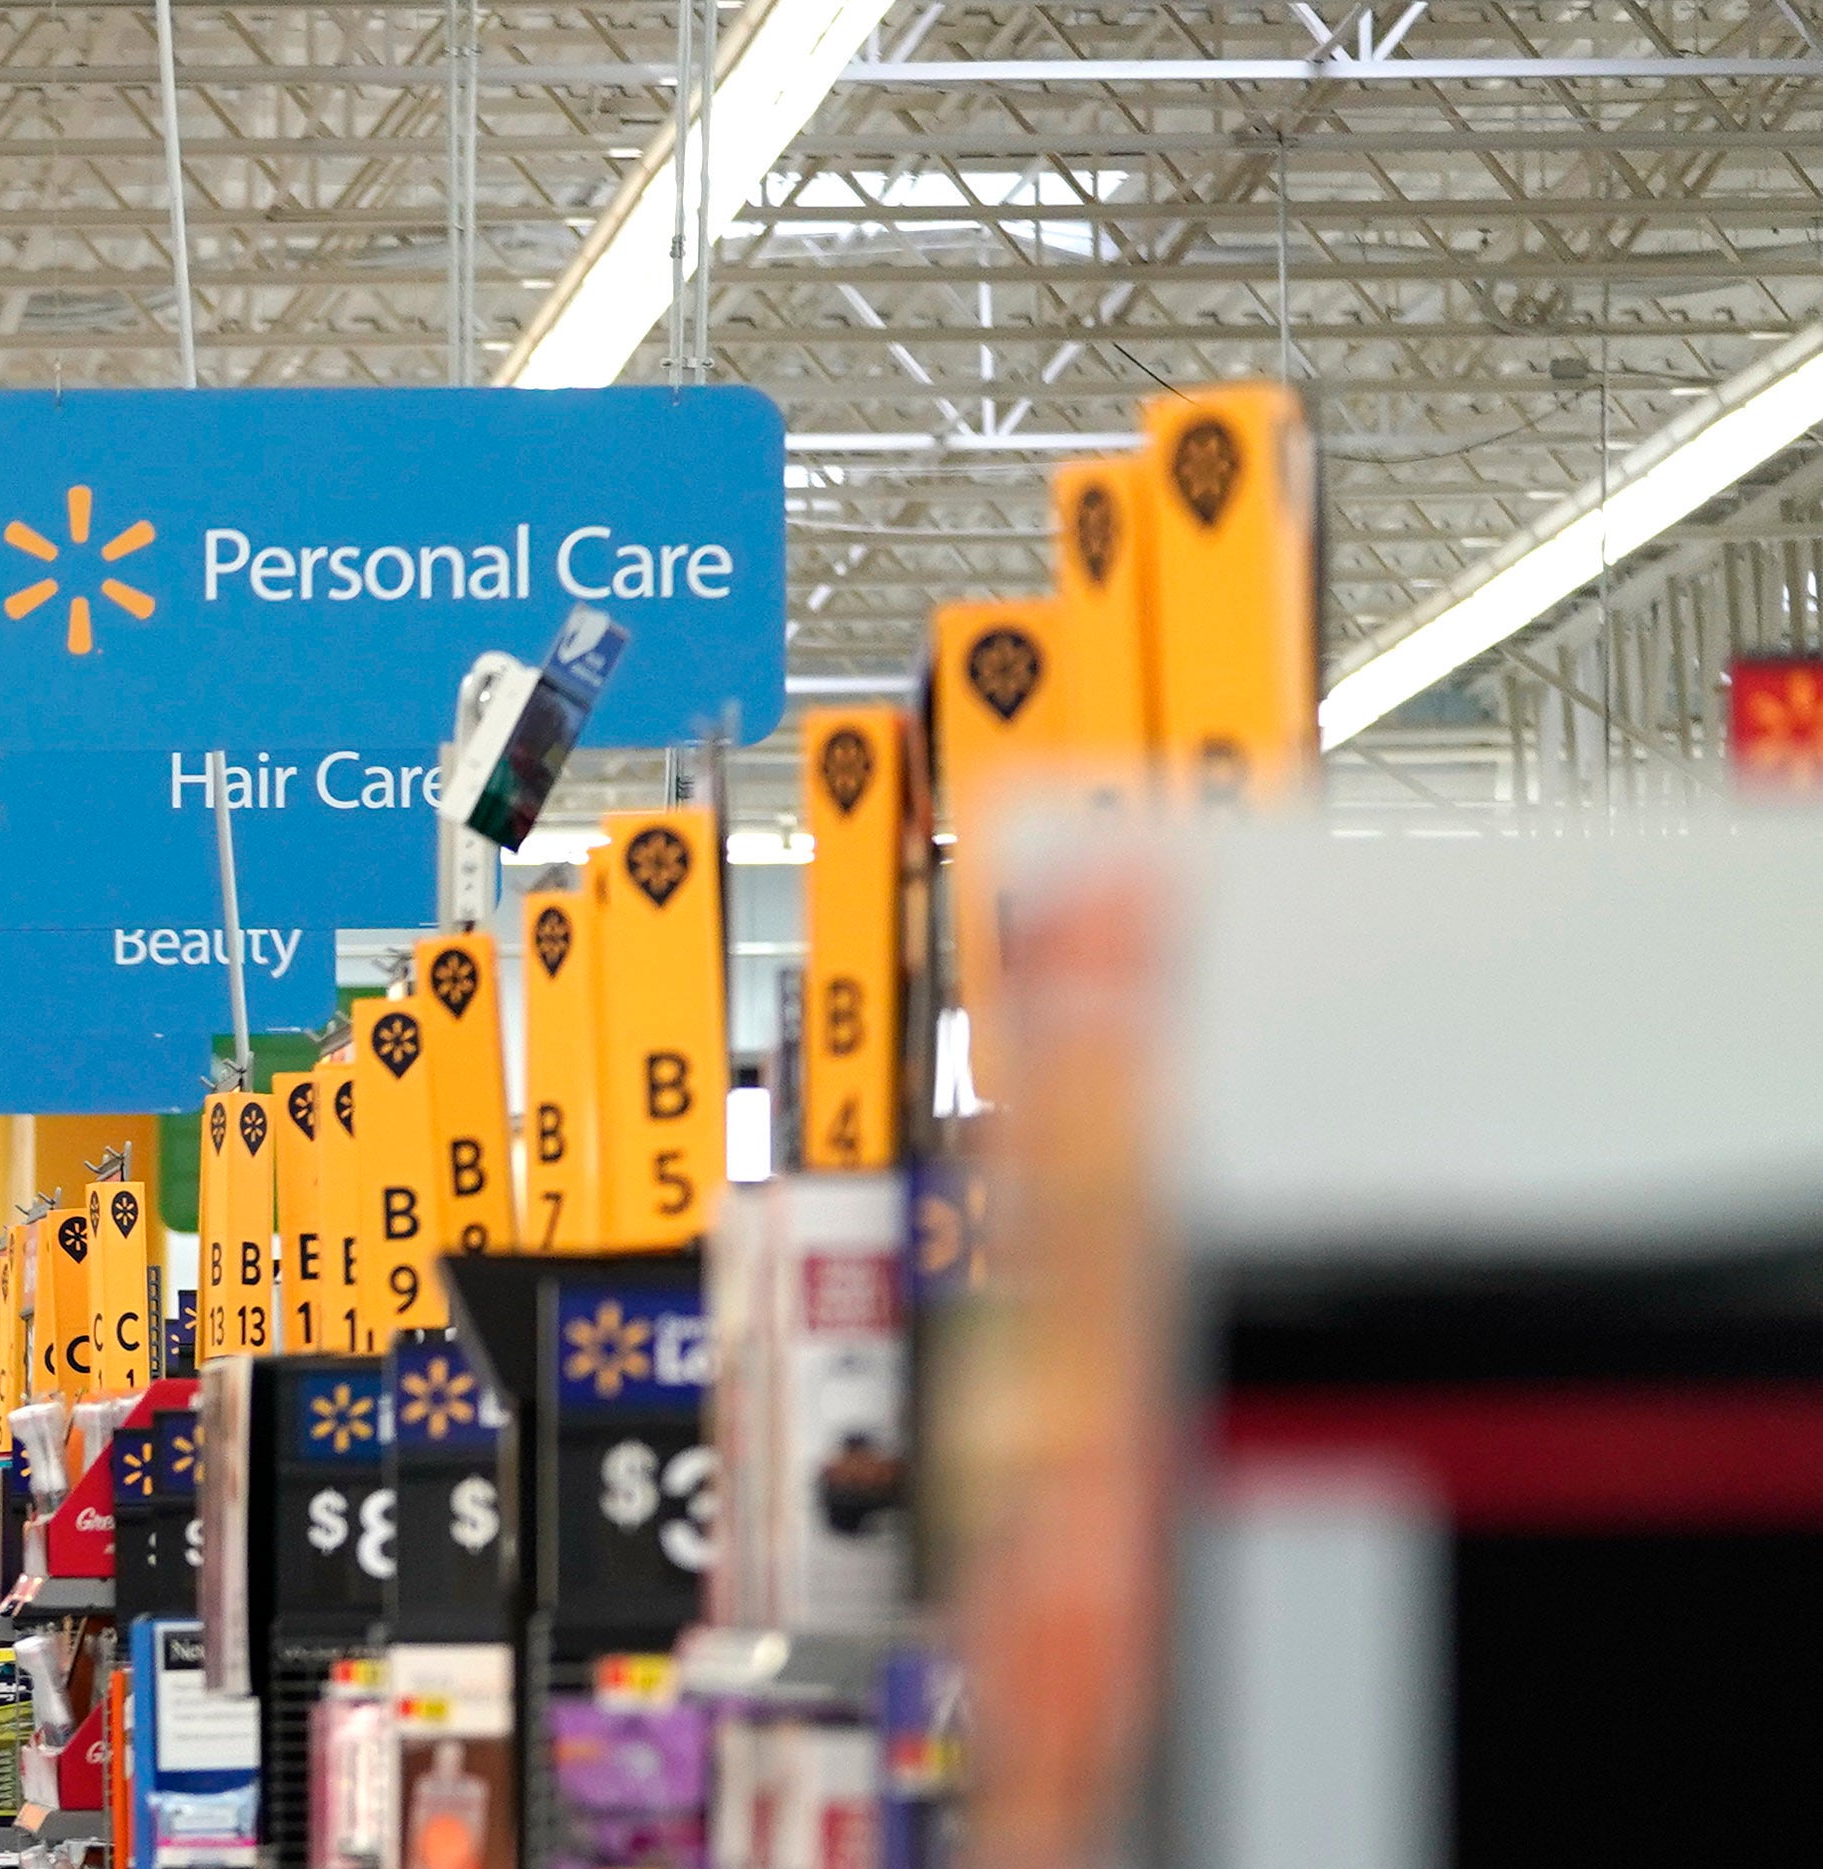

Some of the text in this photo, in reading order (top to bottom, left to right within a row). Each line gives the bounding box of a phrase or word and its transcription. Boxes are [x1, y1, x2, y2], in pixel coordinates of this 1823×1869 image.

[203, 523, 733, 602] Personal Care
[170, 751, 449, 810] Hair Care
[114, 928, 302, 978] Beauty
[645, 1052, 691, 1120] B
[537, 1104, 564, 1164] B
[454, 1139, 483, 1197] B
[654, 1152, 692, 1216] 5
[384, 1188, 418, 1240] B
[242, 1241, 260, 1285] B
[390, 1265, 418, 1314] 9
[117, 1313, 139, 1351] C
[237, 1306, 265, 1346] 13
